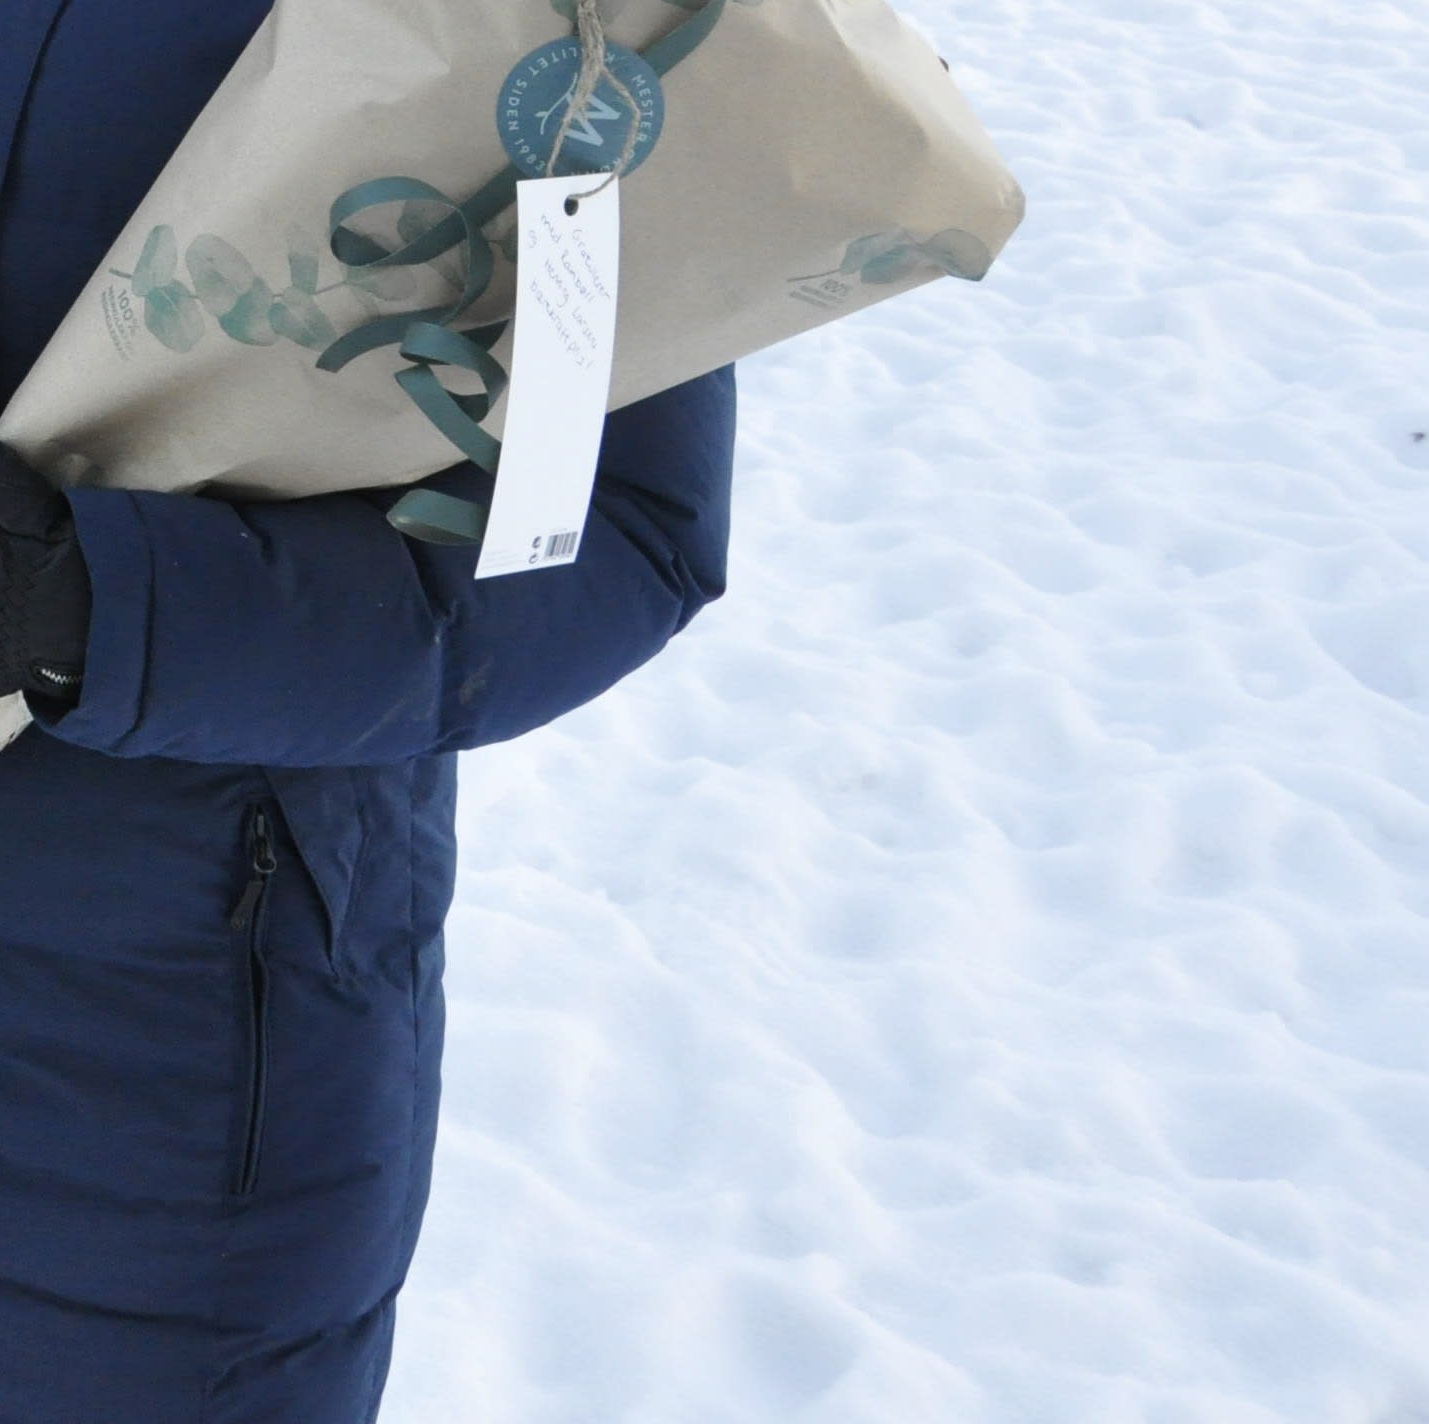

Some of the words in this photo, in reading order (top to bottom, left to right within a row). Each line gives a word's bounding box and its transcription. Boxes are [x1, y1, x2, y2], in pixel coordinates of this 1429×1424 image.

[507, 79, 527, 131] SIDEN
[632, 74, 654, 143] MESTER
[514, 139, 546, 172] 1983
